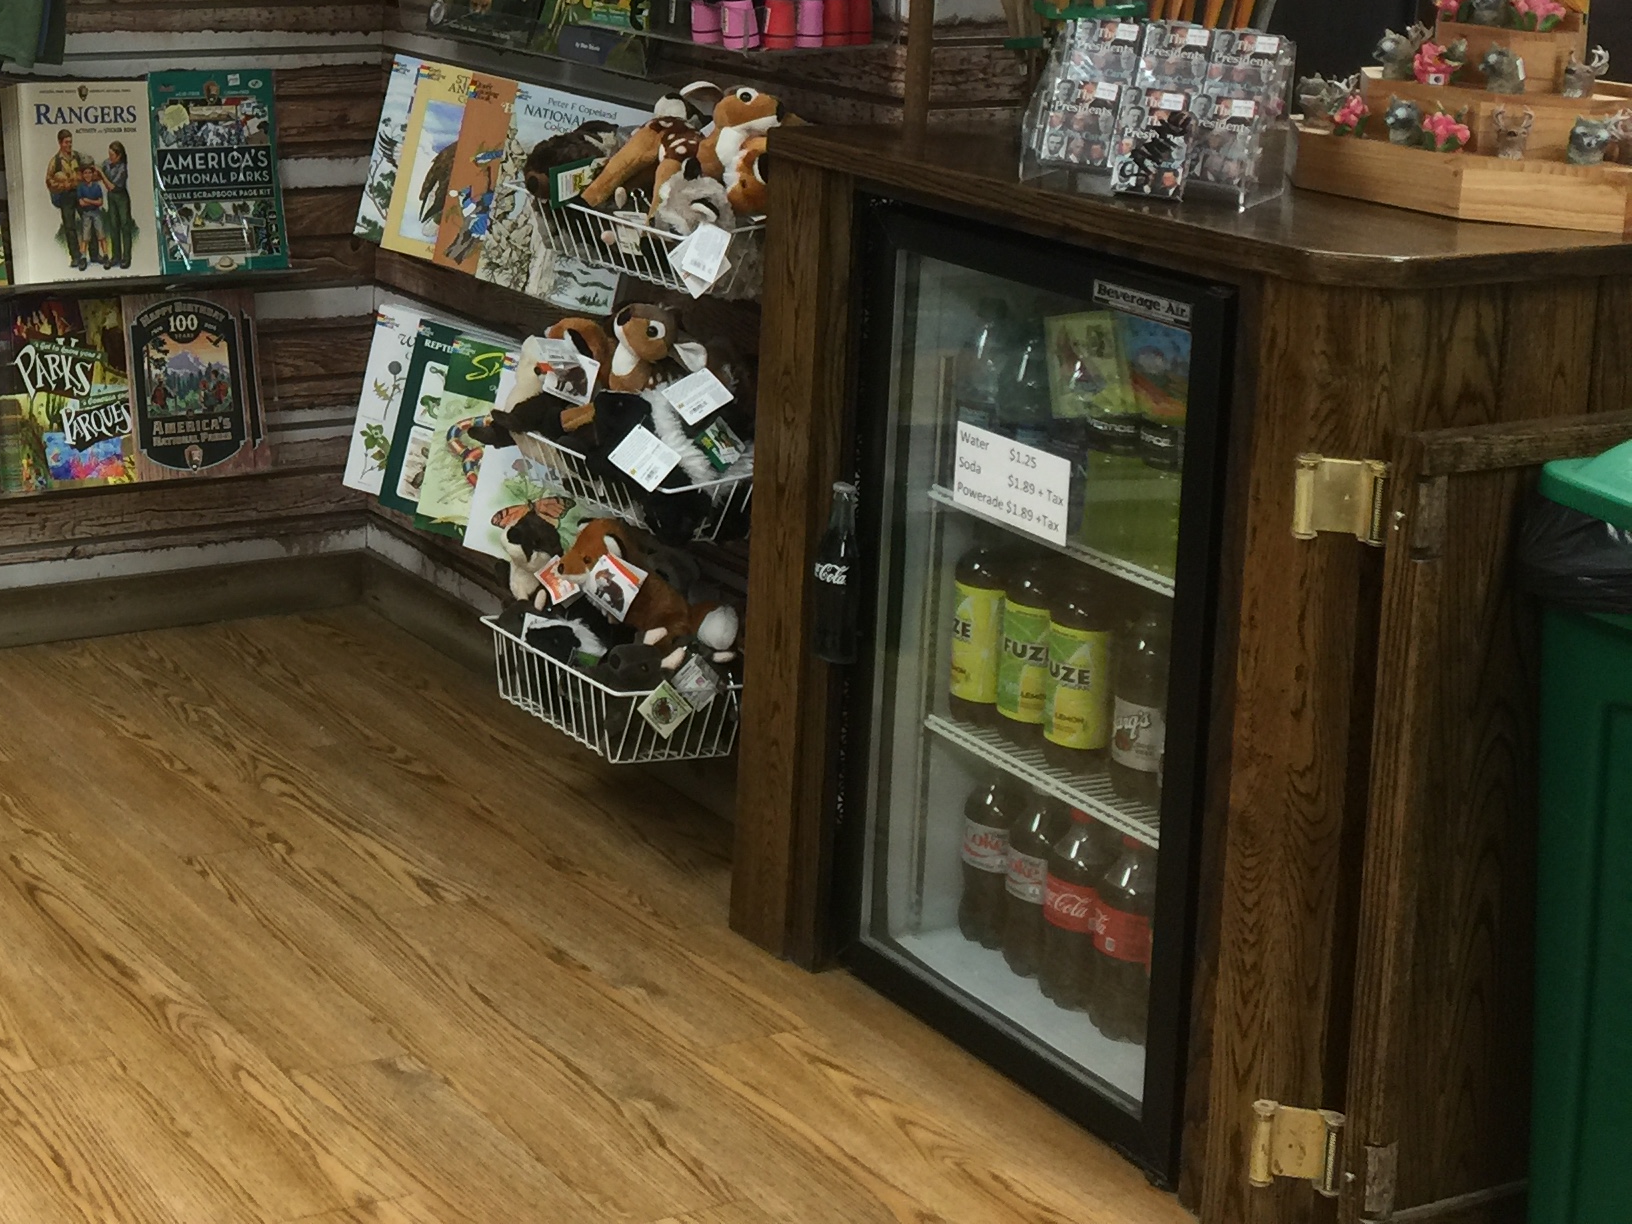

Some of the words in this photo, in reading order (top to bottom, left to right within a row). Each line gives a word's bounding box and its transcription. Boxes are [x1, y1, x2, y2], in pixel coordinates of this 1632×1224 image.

[1077, 41, 1135, 56] Presidents
[1147, 46, 1205, 61] Presidents
[1215, 52, 1275, 68] Presidents
[34, 103, 137, 125] RANGERS
[547, 96, 569, 108] Peter
[578, 103, 618, 120] Copeland
[1055, 100, 1112, 116] Presidents
[162, 148, 269, 171] AMERICA'S
[162, 171, 227, 186] NATIONAL
[230, 169, 270, 182] PARKS
[163, 191, 192, 201] DELUXE
[193, 189, 238, 200] SCRAPBOOK
[239, 188, 259, 197] PAGE
[259, 187, 273, 197] KIT
[139, 303, 174, 329] HAPPY
[174, 301, 227, 323] BIRTHDAY
[169, 314, 199, 333] 100
[15, 343, 94, 400] PARKS
[60, 402, 132, 446] PARQUES
[153, 417, 233, 436] AMERICA'S
[153, 434, 197, 447] NATIONAL
[199, 431, 233, 445] PARKS
[961, 430, 990, 452] Water
[1009, 448, 1037, 470] $1.25
[958, 456, 982, 475] Soda
[1007, 474, 1035, 496] $1.89
[1047, 490, 1064, 507] Tax
[957, 481, 1004, 511] Powerade
[1006, 501, 1034, 523] $1.89
[1054, 712, 1085, 725] LEMON
